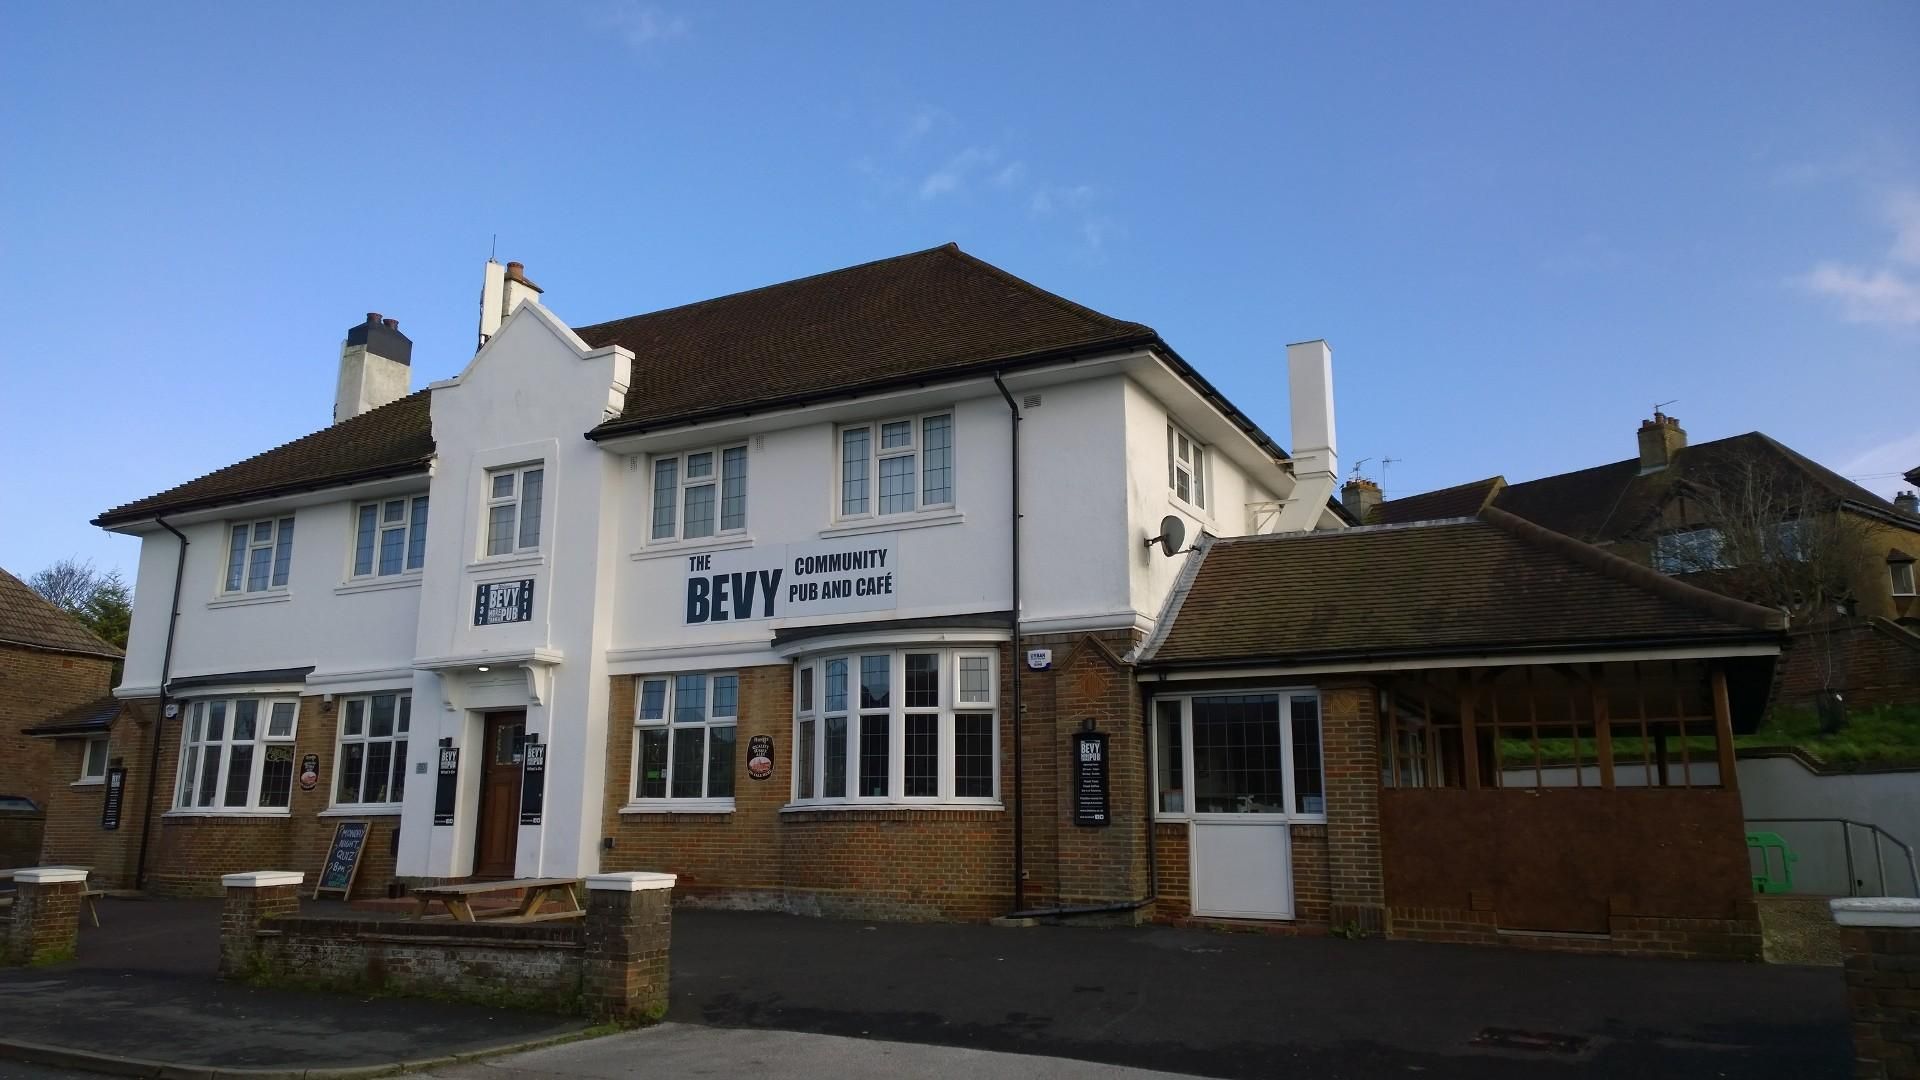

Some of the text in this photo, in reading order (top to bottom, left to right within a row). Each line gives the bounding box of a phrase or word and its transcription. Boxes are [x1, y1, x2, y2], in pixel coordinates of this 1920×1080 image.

[689, 554, 711, 571] THE
[794, 548, 888, 576] COMMUNITY
[789, 572, 893, 602] PUB AND CAFÉ
[489, 588, 519, 608] BEVY
[686, 568, 784, 624] BEVY
[500, 607, 519, 621] PUB
[527, 746, 544, 758] BEVY
[1080, 743, 1100, 754] BEVY
[441, 751, 457, 762] BEVY
[336, 849, 355, 861] QUIZ
